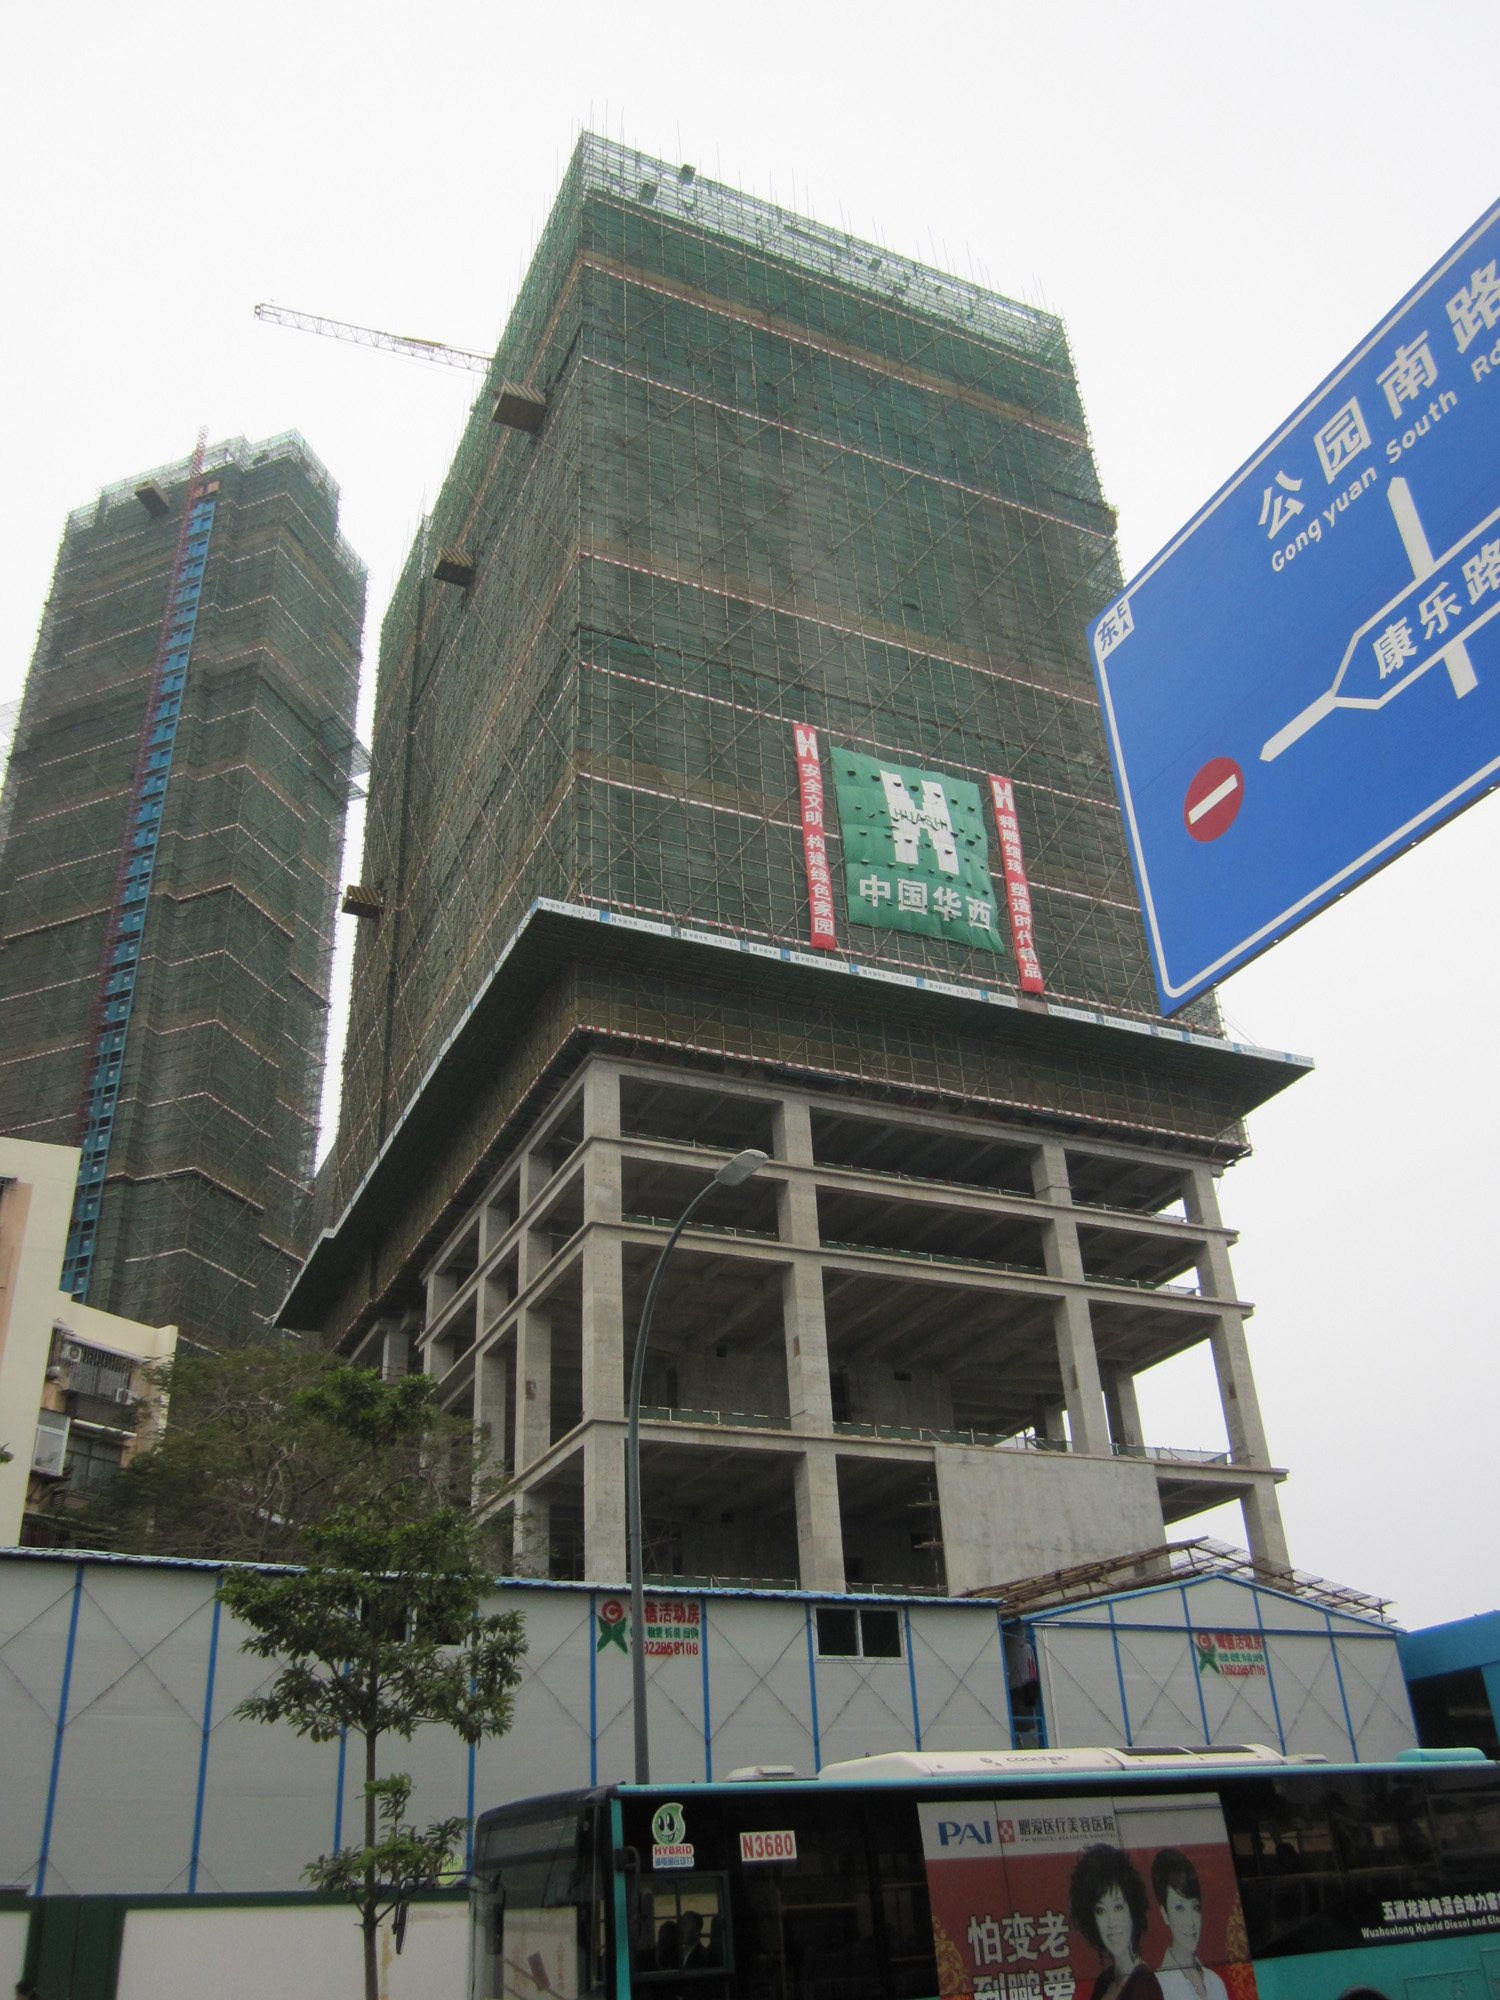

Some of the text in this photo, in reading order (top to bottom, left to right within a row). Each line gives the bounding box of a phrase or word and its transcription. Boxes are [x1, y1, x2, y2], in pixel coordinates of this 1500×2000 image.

[1258, 259, 1500, 540] 公园南路
[1386, 390, 1459, 464] South
[1373, 538, 1500, 680] 康乐路
[1098, 615, 1119, 651] 东
[894, 807, 949, 831] HUASHI
[802, 763, 834, 936] 安全文明 构建绿色家园
[859, 874, 992, 932] 中国华西
[1009, 881, 1043, 980] 塑造时代精品
[629, 1601, 700, 1625] 信活动房
[938, 1820, 993, 1846] PAI
[1018, 1815, 1116, 1836] 鹏爱医疗美容医院
[654, 1845, 693, 1856] HYBRID
[742, 1833, 794, 1859] N3680
[1381, 1891, 1500, 1921] 五洲龙油电混合动力客
[967, 1909, 1070, 1967] 怕变老
[1361, 1924, 1415, 1938] Wuzhoulong
[1415, 1920, 1444, 1935] Hybrid
[1444, 1917, 1471, 1930] Diesel
[1472, 1915, 1487, 1925] and
